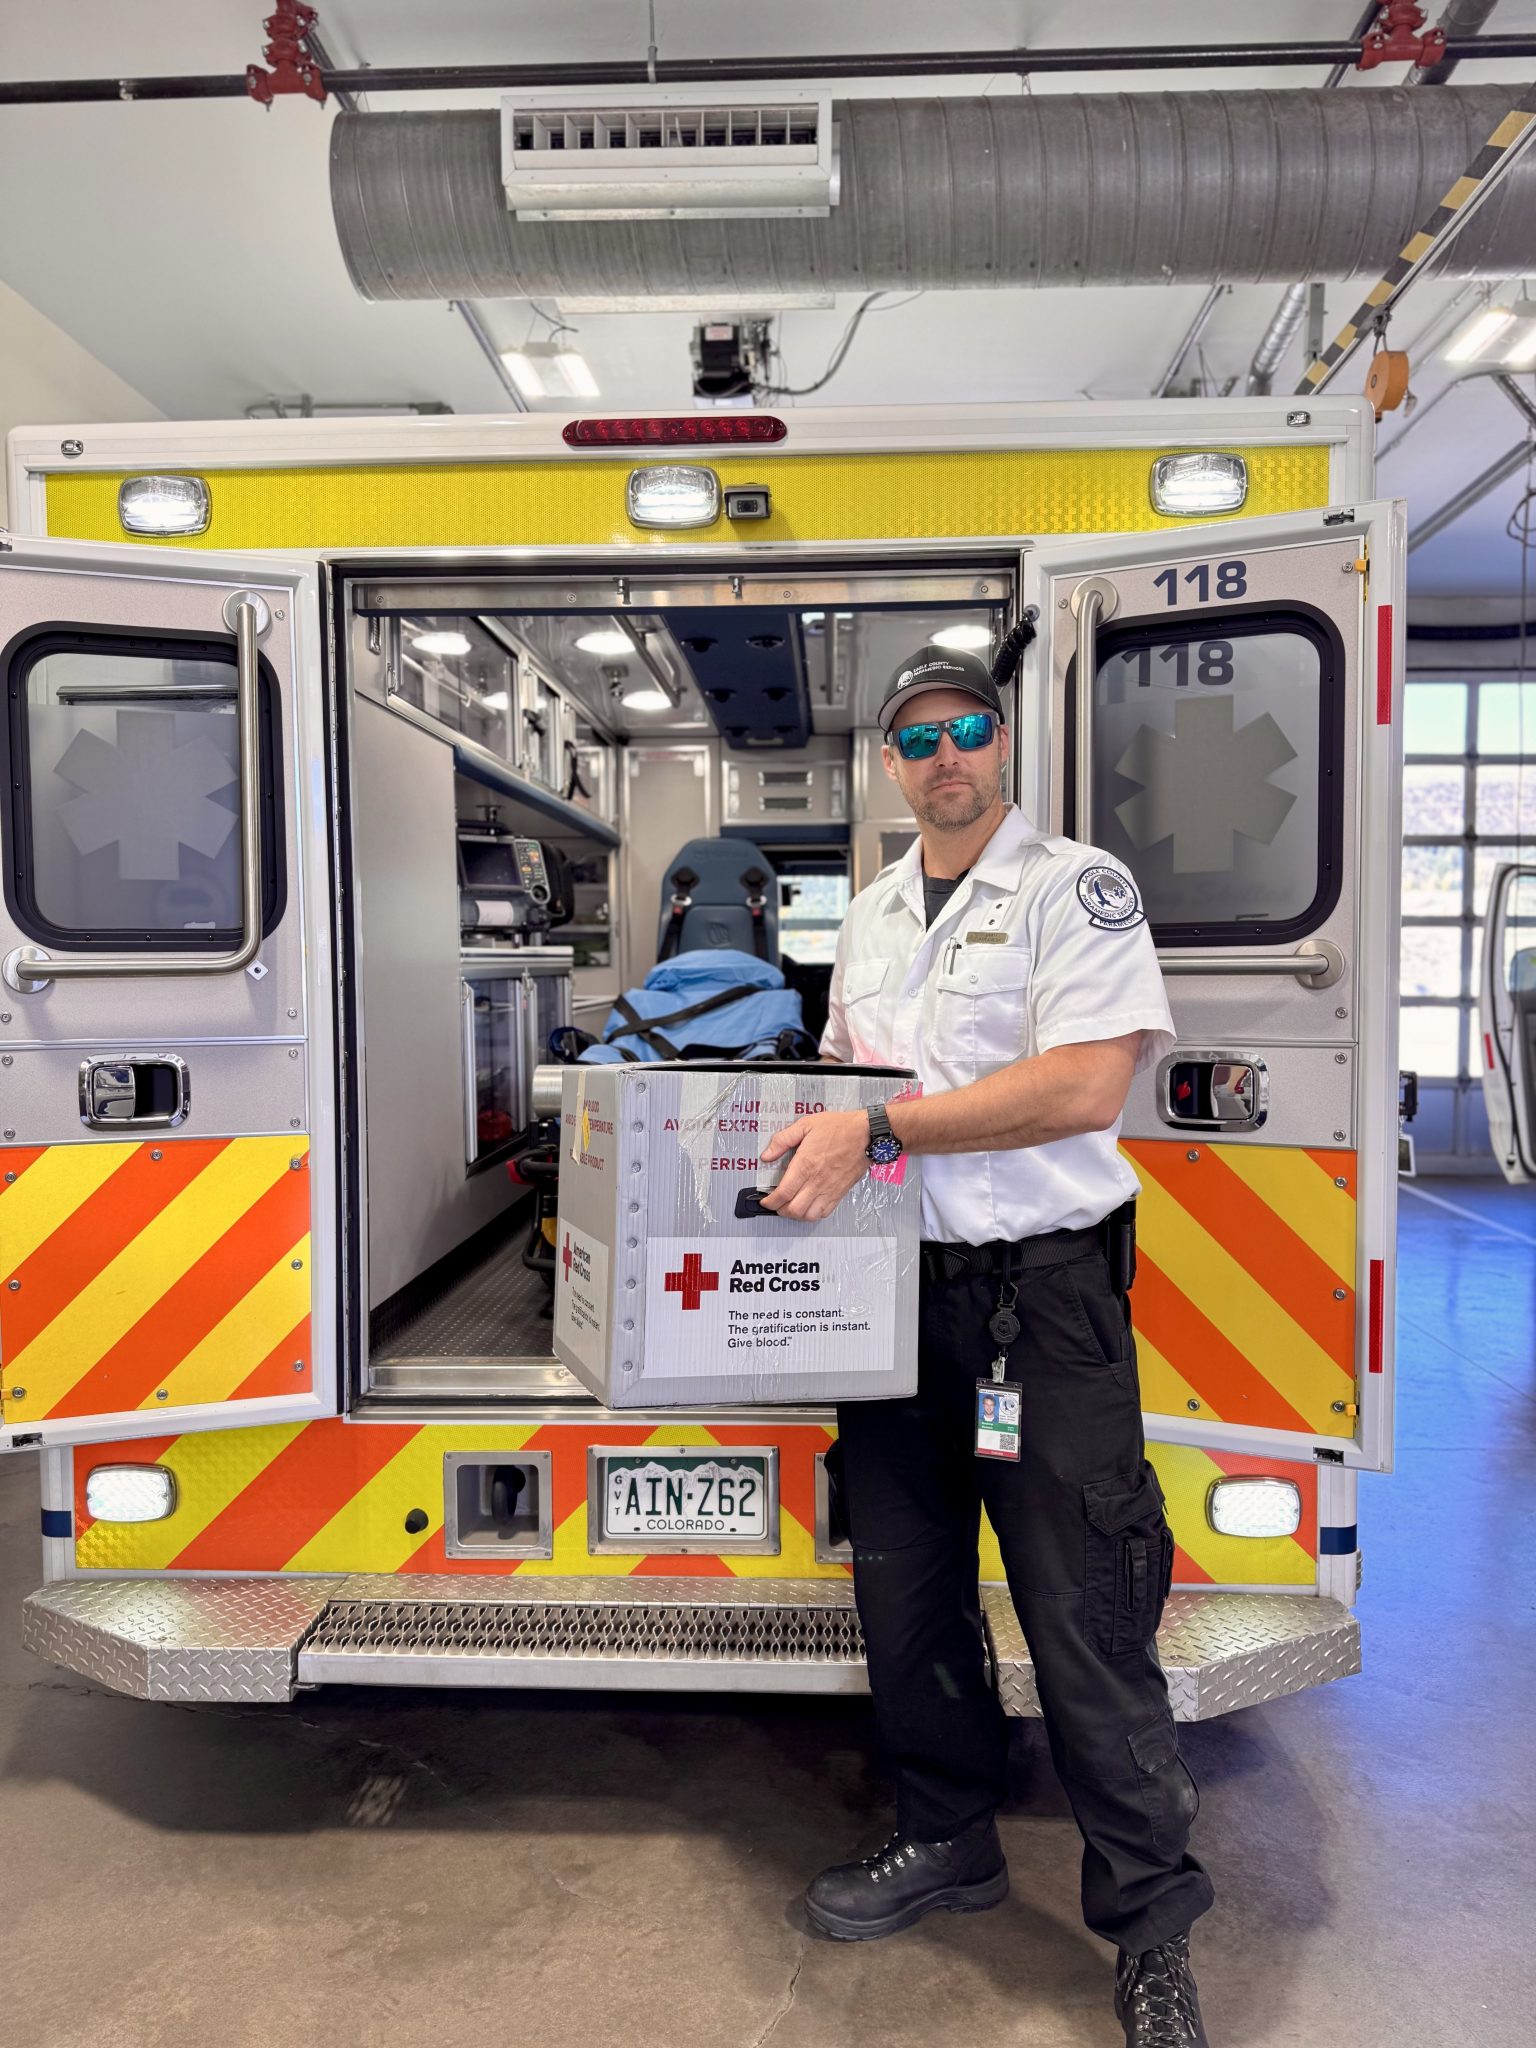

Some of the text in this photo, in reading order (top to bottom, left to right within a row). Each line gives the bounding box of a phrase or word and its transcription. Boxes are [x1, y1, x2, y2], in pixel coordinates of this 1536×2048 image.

[1152, 560, 1248, 606] 118
[1121, 640, 1235, 688] 118
[1081, 869, 1129, 888] EAGLE COUNTY
[1080, 894, 1117, 918] PARAMEDIC
[1099, 914, 1139, 927] PARAMEDIC
[731, 1101, 790, 1114] HUMAN
[730, 1259, 820, 1274] American
[729, 1277, 821, 1293] Red Cross
[728, 1308, 845, 1320] The need is constant.
[727, 1321, 871, 1336] The gratification is instant.
[727, 1338, 753, 1348] Give
[646, 1519, 725, 1531] COLORADO
